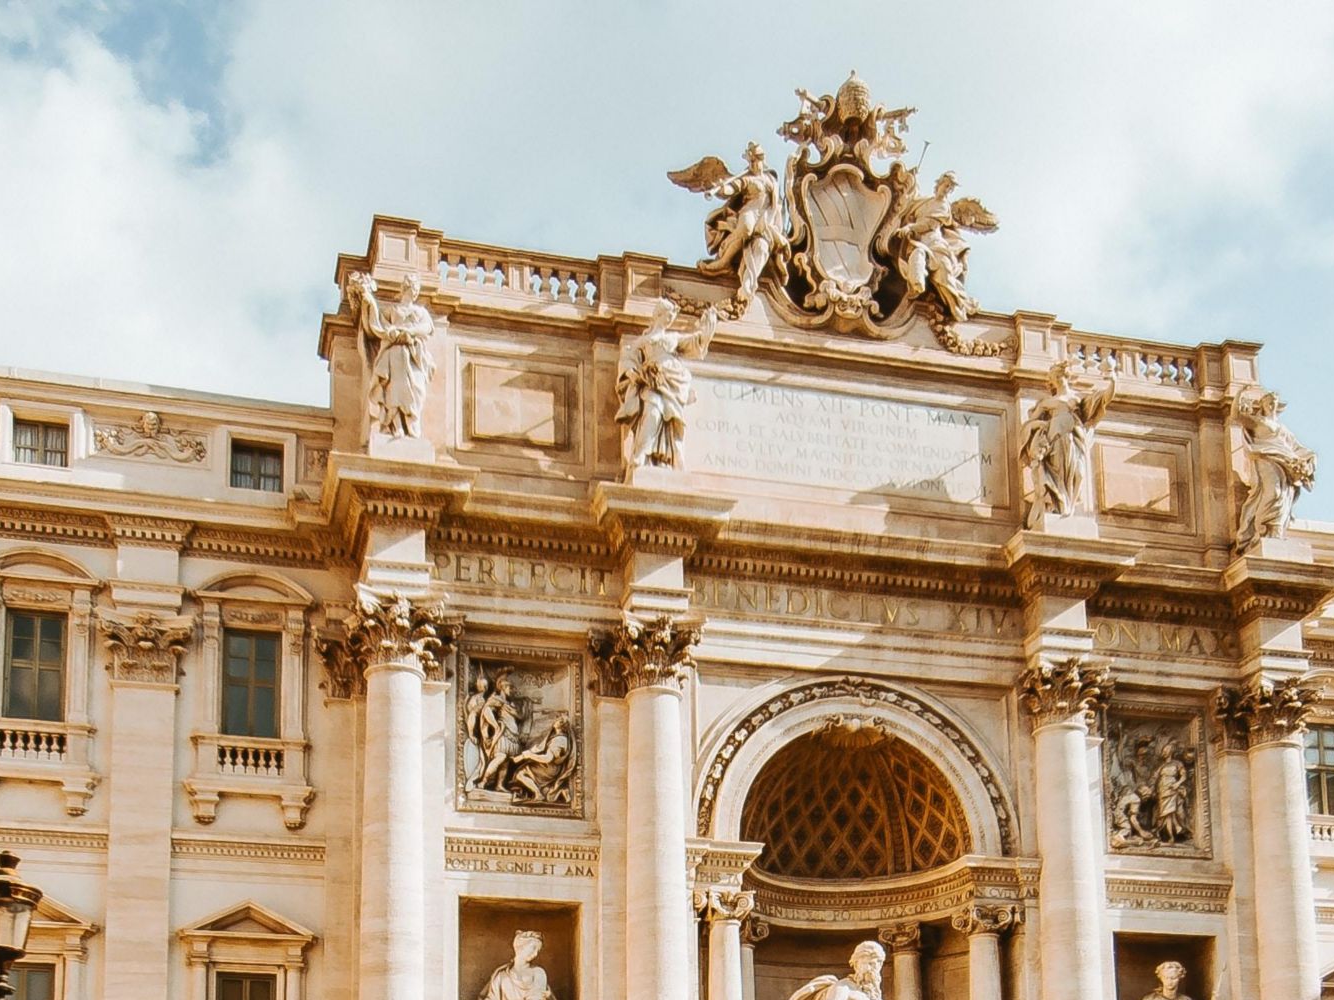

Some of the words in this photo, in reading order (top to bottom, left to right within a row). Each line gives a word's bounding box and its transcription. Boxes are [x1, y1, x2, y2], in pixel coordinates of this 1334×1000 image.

[712, 383, 805, 408] CLEMENS
[695, 417, 741, 434] COPIA
[842, 419, 917, 440] VIRGINEM
[703, 453, 750, 471] ANNO
[432, 552, 613, 596] PERFECIT
[692, 577, 919, 625] BENEDICTVS
[542, 864, 557, 875] ET
[564, 865, 595, 878] ANA
